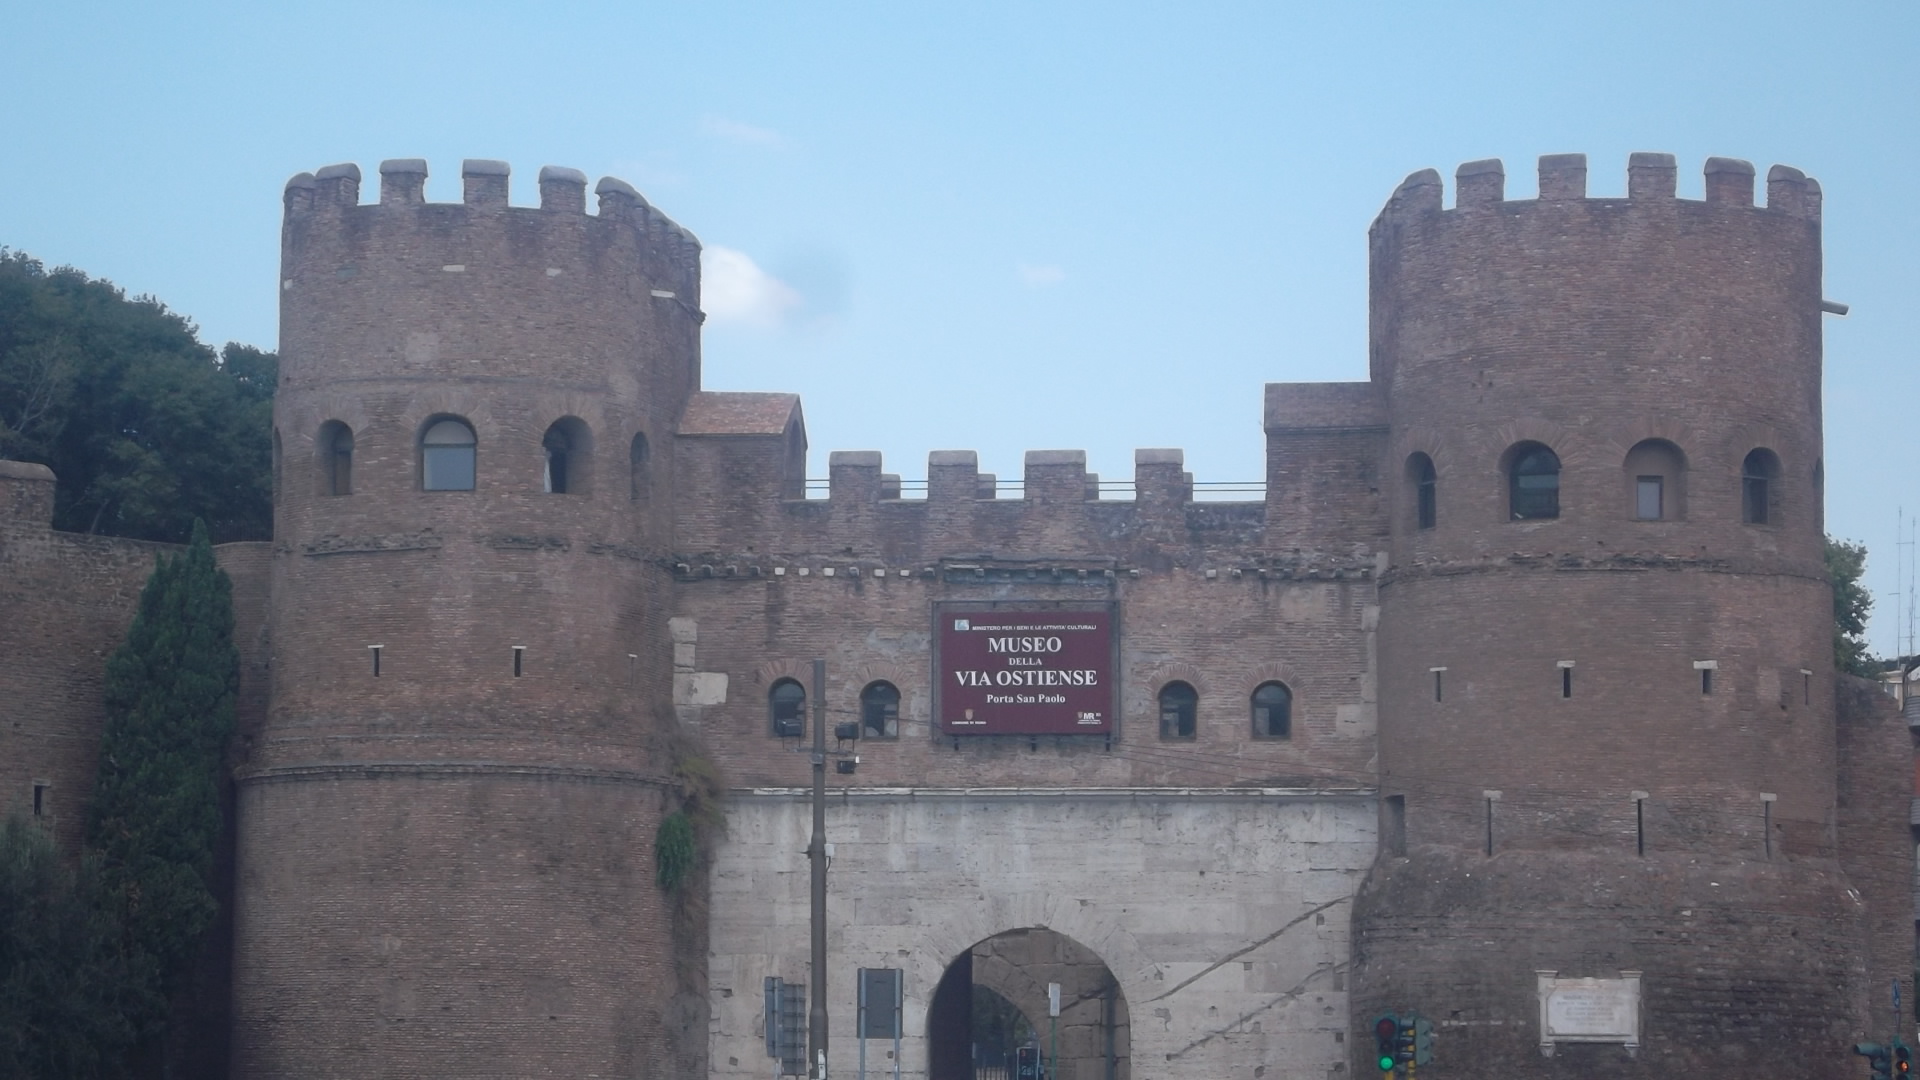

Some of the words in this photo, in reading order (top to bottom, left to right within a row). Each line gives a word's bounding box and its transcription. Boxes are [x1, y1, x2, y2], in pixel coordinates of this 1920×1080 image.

[988, 637, 1062, 653] MUSEO
[1009, 657, 1042, 666] DELLA
[955, 670, 992, 686] VIA
[996, 670, 1098, 686] OSTIENSE
[987, 694, 1014, 703] Porta
[1016, 694, 1035, 703] San
[1038, 694, 1066, 703] Paolo
